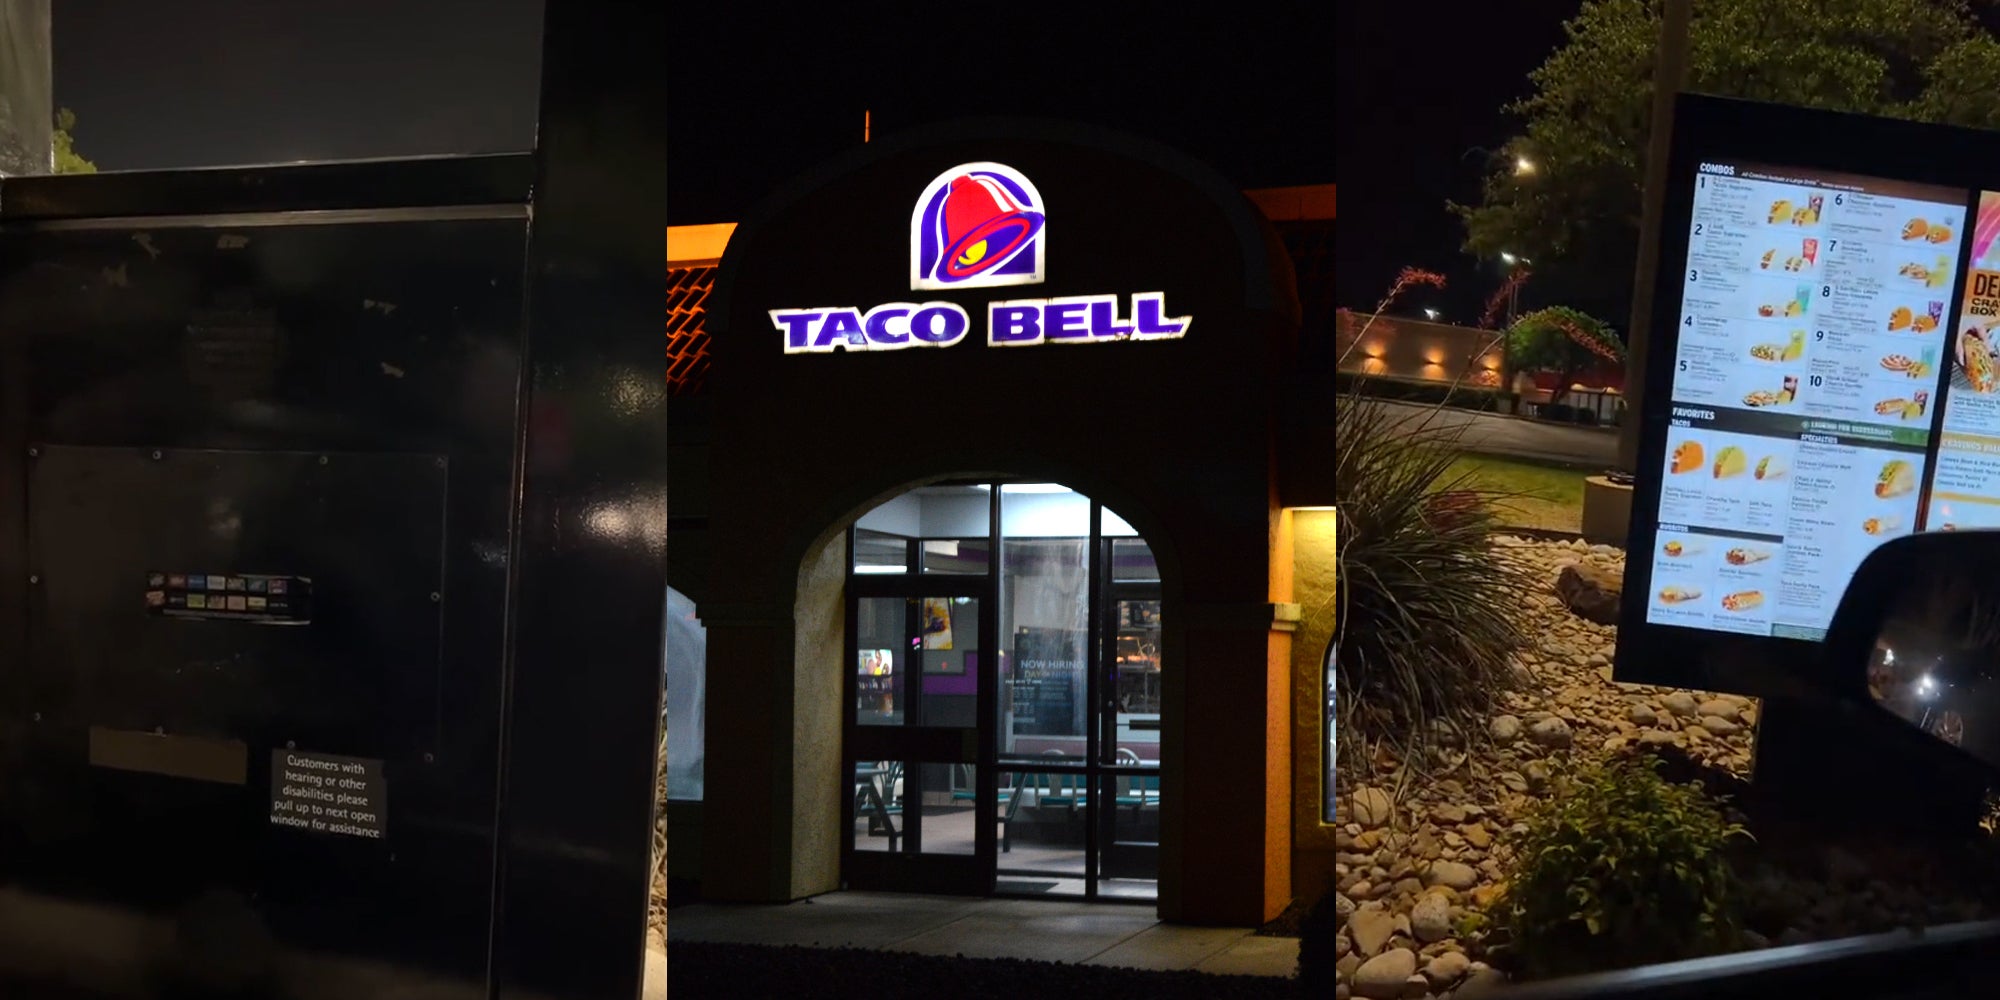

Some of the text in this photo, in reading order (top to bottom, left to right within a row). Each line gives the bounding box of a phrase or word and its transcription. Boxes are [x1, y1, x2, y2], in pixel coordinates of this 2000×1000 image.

[1700, 162, 1735, 175] COMBOS
[1701, 177, 1705, 188] 1
[1835, 194, 1843, 205] 6
[1694, 223, 1703, 235] 2
[1829, 240, 1837, 252] 7
[1689, 270, 1697, 281] 3
[1822, 286, 1830, 297] 8
[1970, 306, 1997, 317] BOX
[774, 297, 1186, 349] TACO BELL
[1684, 316, 1692, 326] 4
[1816, 331, 1824, 341] 9
[1680, 360, 1687, 371] 5
[1810, 375, 1822, 387] 10
[1672, 407, 1715, 420] FAVORITES
[1671, 418, 1691, 427] TACOS
[1021, 660, 1085, 669] NOW HIRING
[1024, 670, 1041, 678] DAY
[287, 754, 365, 775] Customers with
[285, 770, 367, 790] hearing or other
[282, 785, 368, 807] disabilities please
[274, 800, 376, 823] pull up to next open
[270, 814, 380, 838] window for assistance
